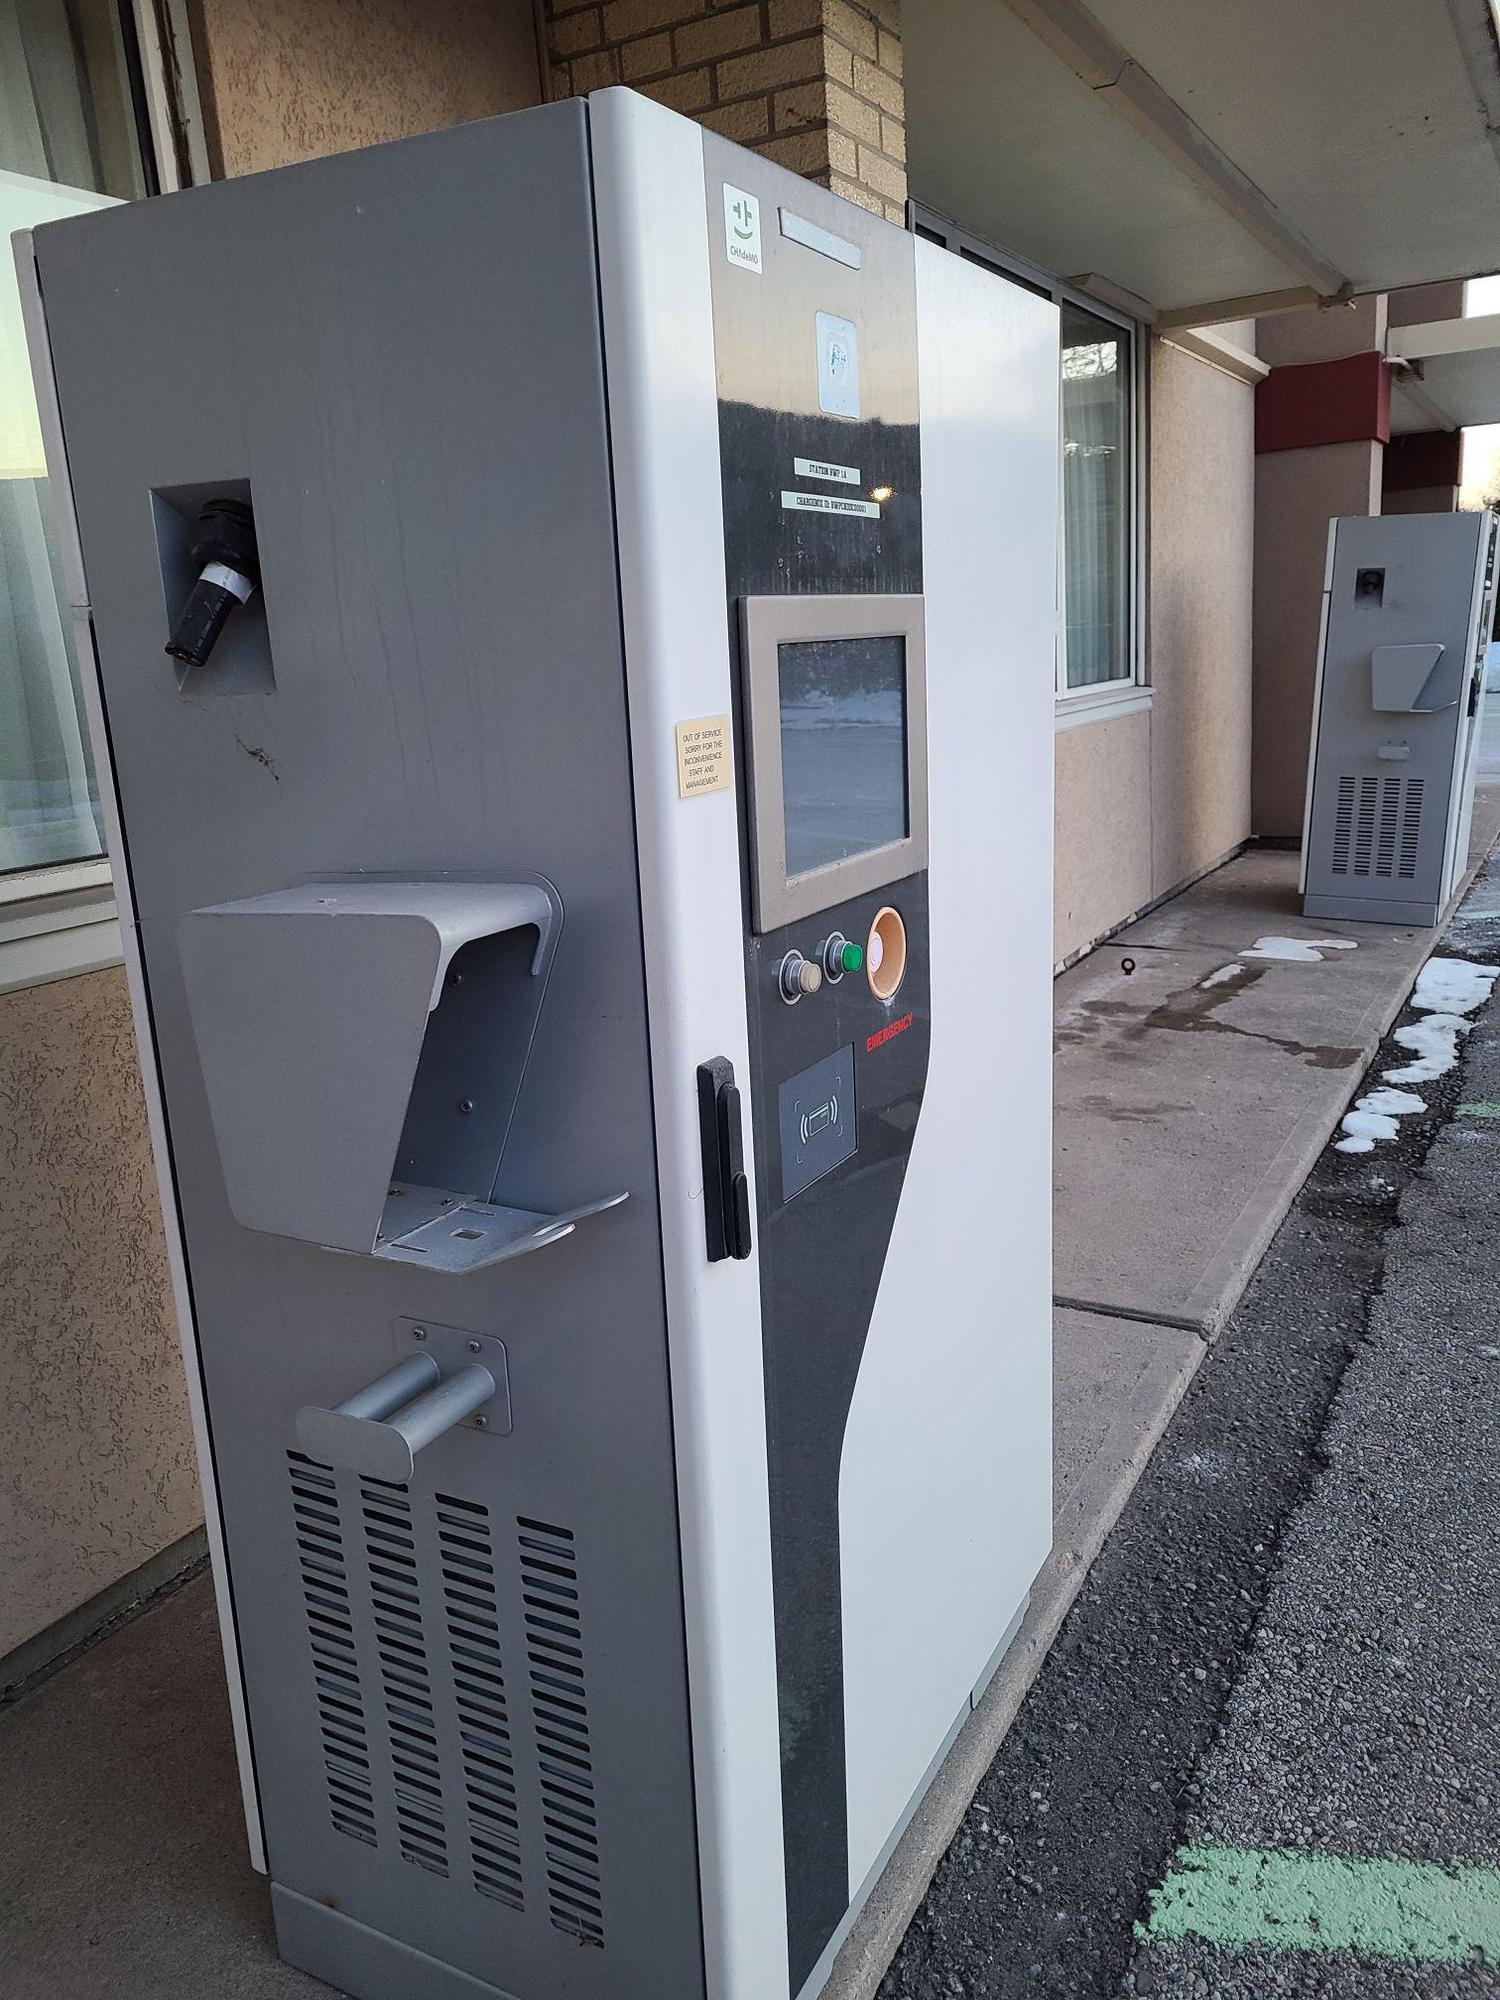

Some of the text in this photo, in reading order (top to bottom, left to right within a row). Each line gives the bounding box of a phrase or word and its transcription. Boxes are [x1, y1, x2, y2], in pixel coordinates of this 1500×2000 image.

[809, 464, 829, 475] STATION
[683, 729, 722, 742] OUT OF SERVICE
[685, 740, 723, 754] SORRY FOR THE
[684, 752, 723, 766] INCONVENIENCE
[689, 765, 715, 777] STAFF AND
[686, 776, 719, 789] MANAGEMENT
[866, 1011, 913, 1053] EMERGENCY
